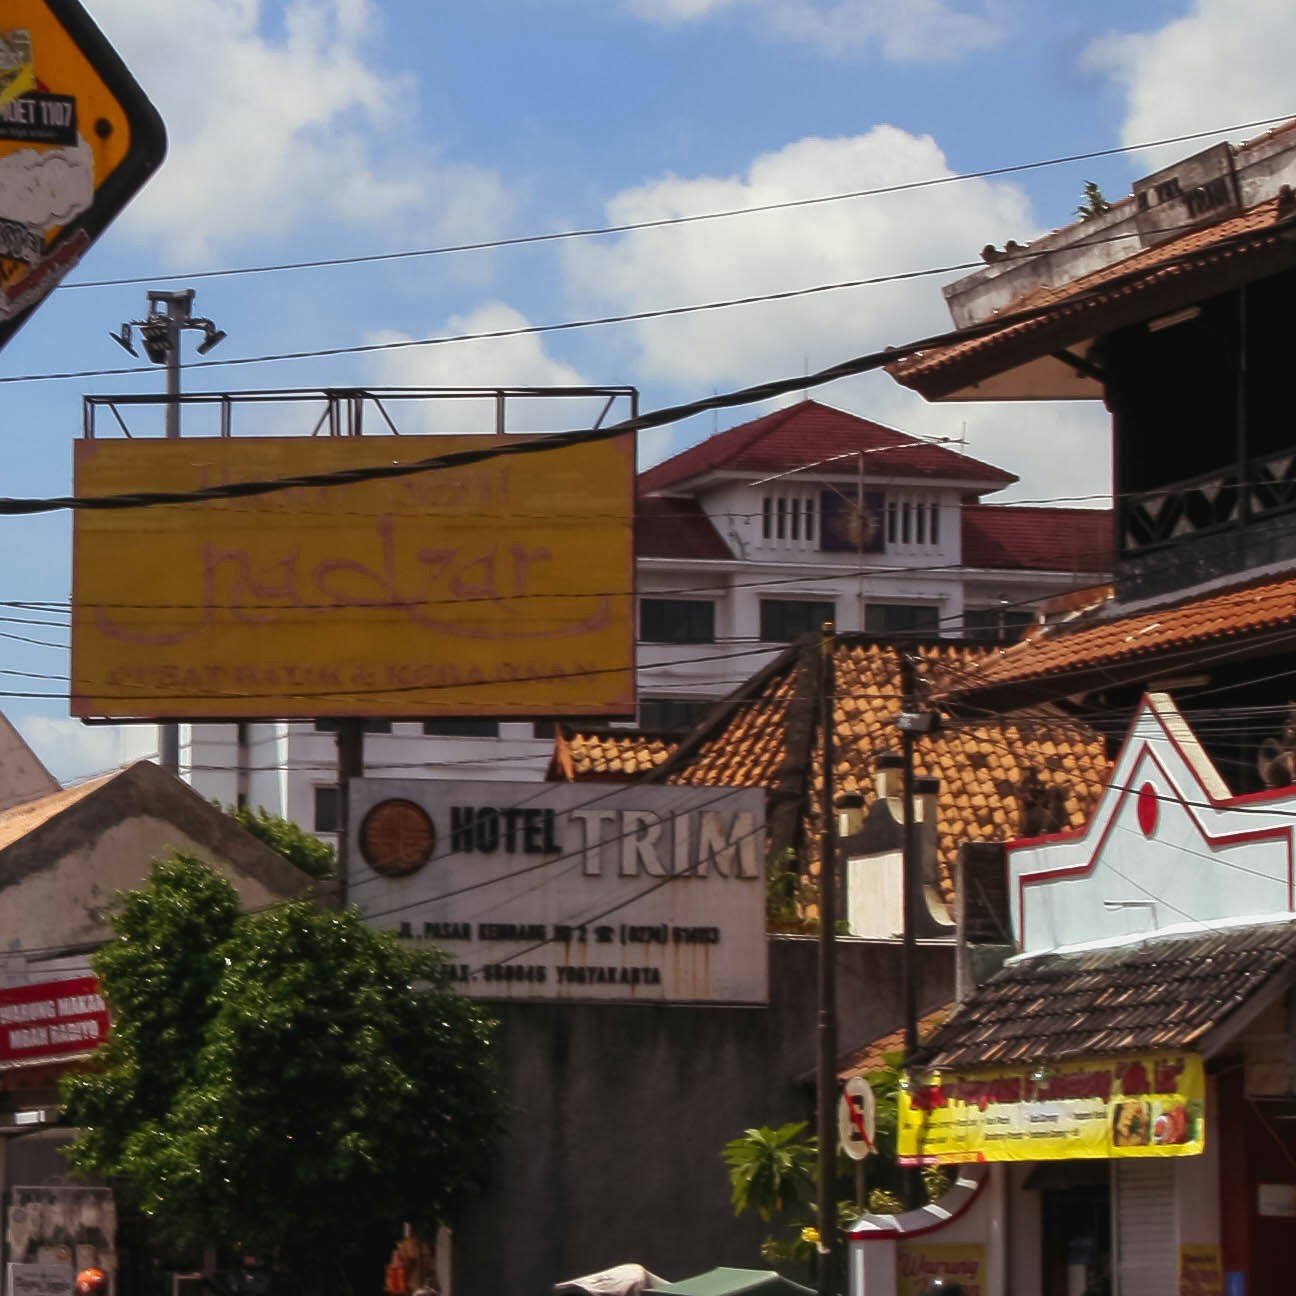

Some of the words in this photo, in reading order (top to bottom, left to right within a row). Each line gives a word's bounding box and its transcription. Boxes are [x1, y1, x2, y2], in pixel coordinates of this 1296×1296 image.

[451, 806, 562, 854] HOTEL
[569, 809, 759, 879] TRIM
[424, 921, 471, 941] PASAR
[556, 966, 661, 986] YOGYAKARTA
